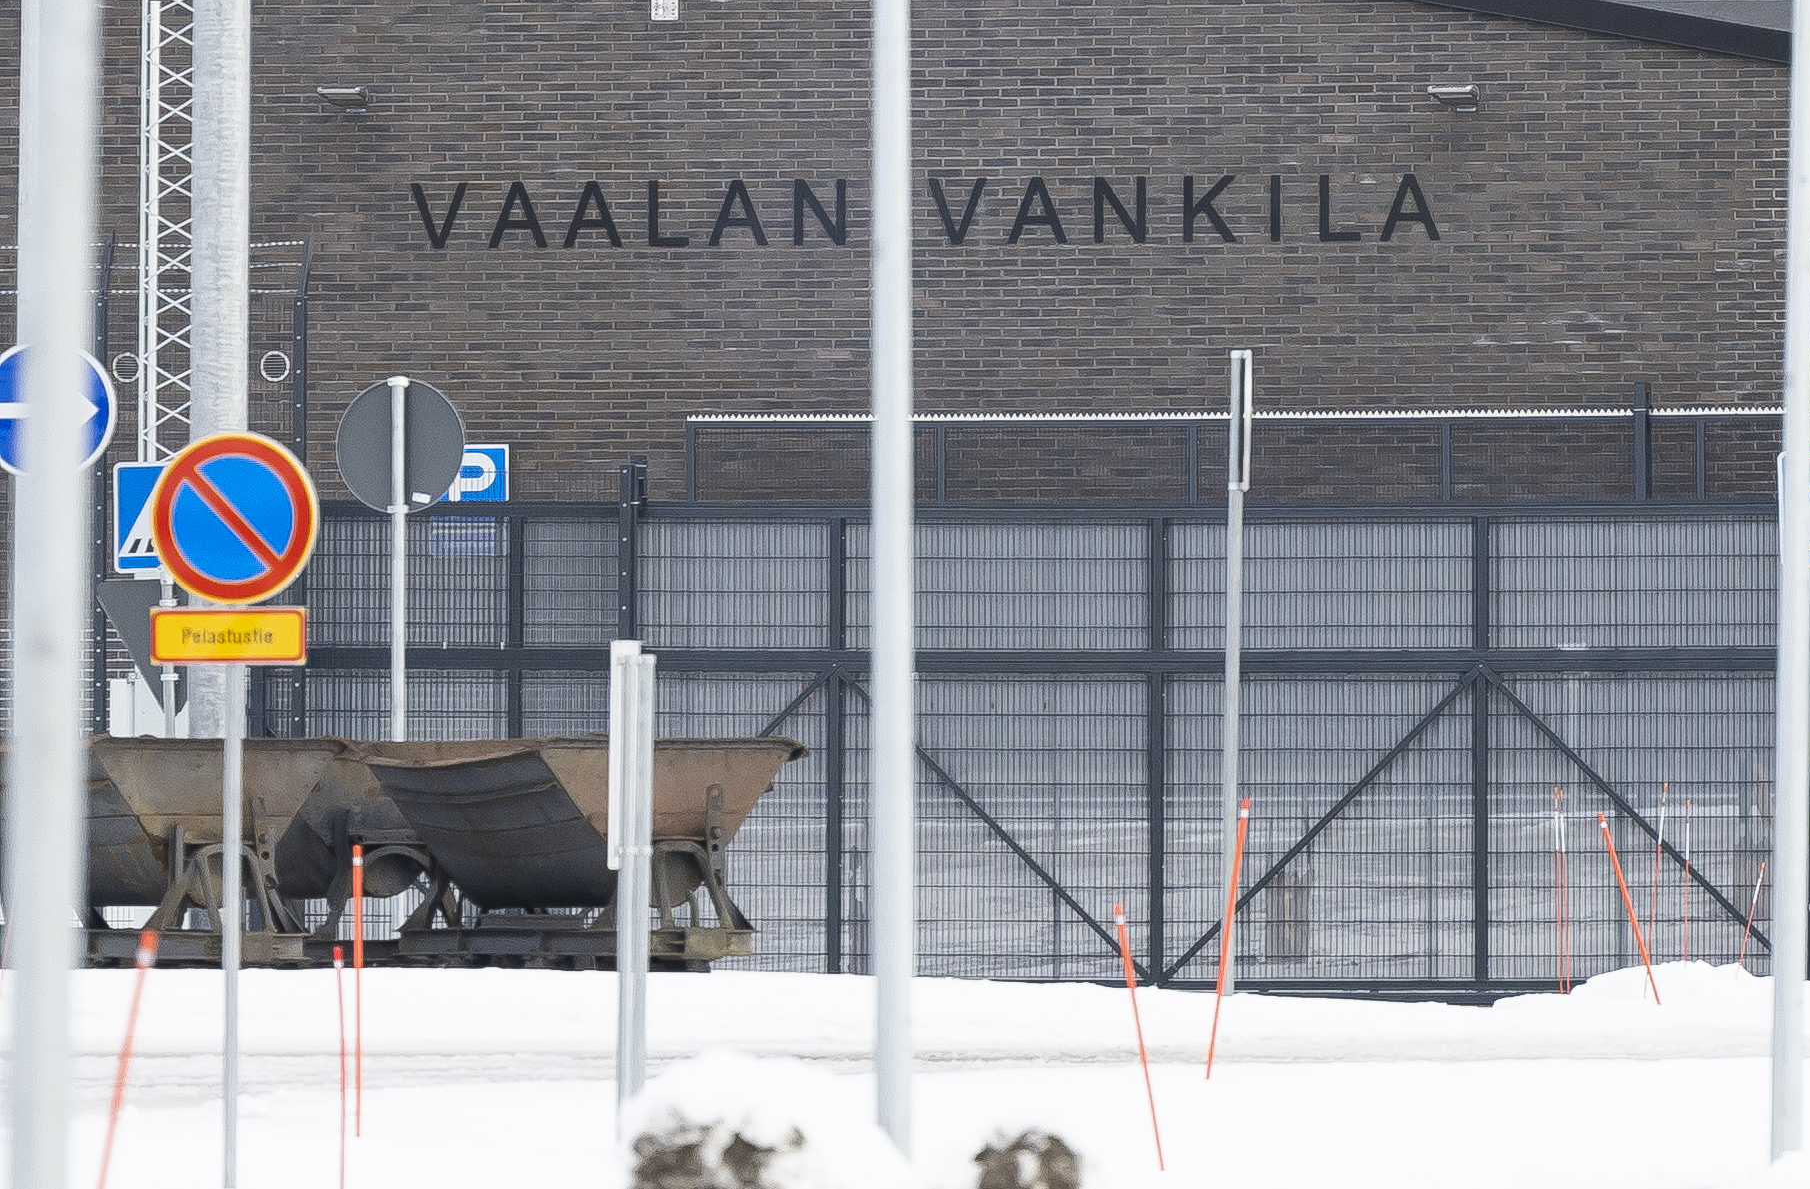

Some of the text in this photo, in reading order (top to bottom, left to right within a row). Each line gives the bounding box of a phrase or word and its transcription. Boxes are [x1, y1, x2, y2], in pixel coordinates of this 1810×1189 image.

[410, 173, 1441, 249] VAALAN VANKILA
[448, 452, 496, 502] P
[181, 628, 273, 644] Pelastustie
